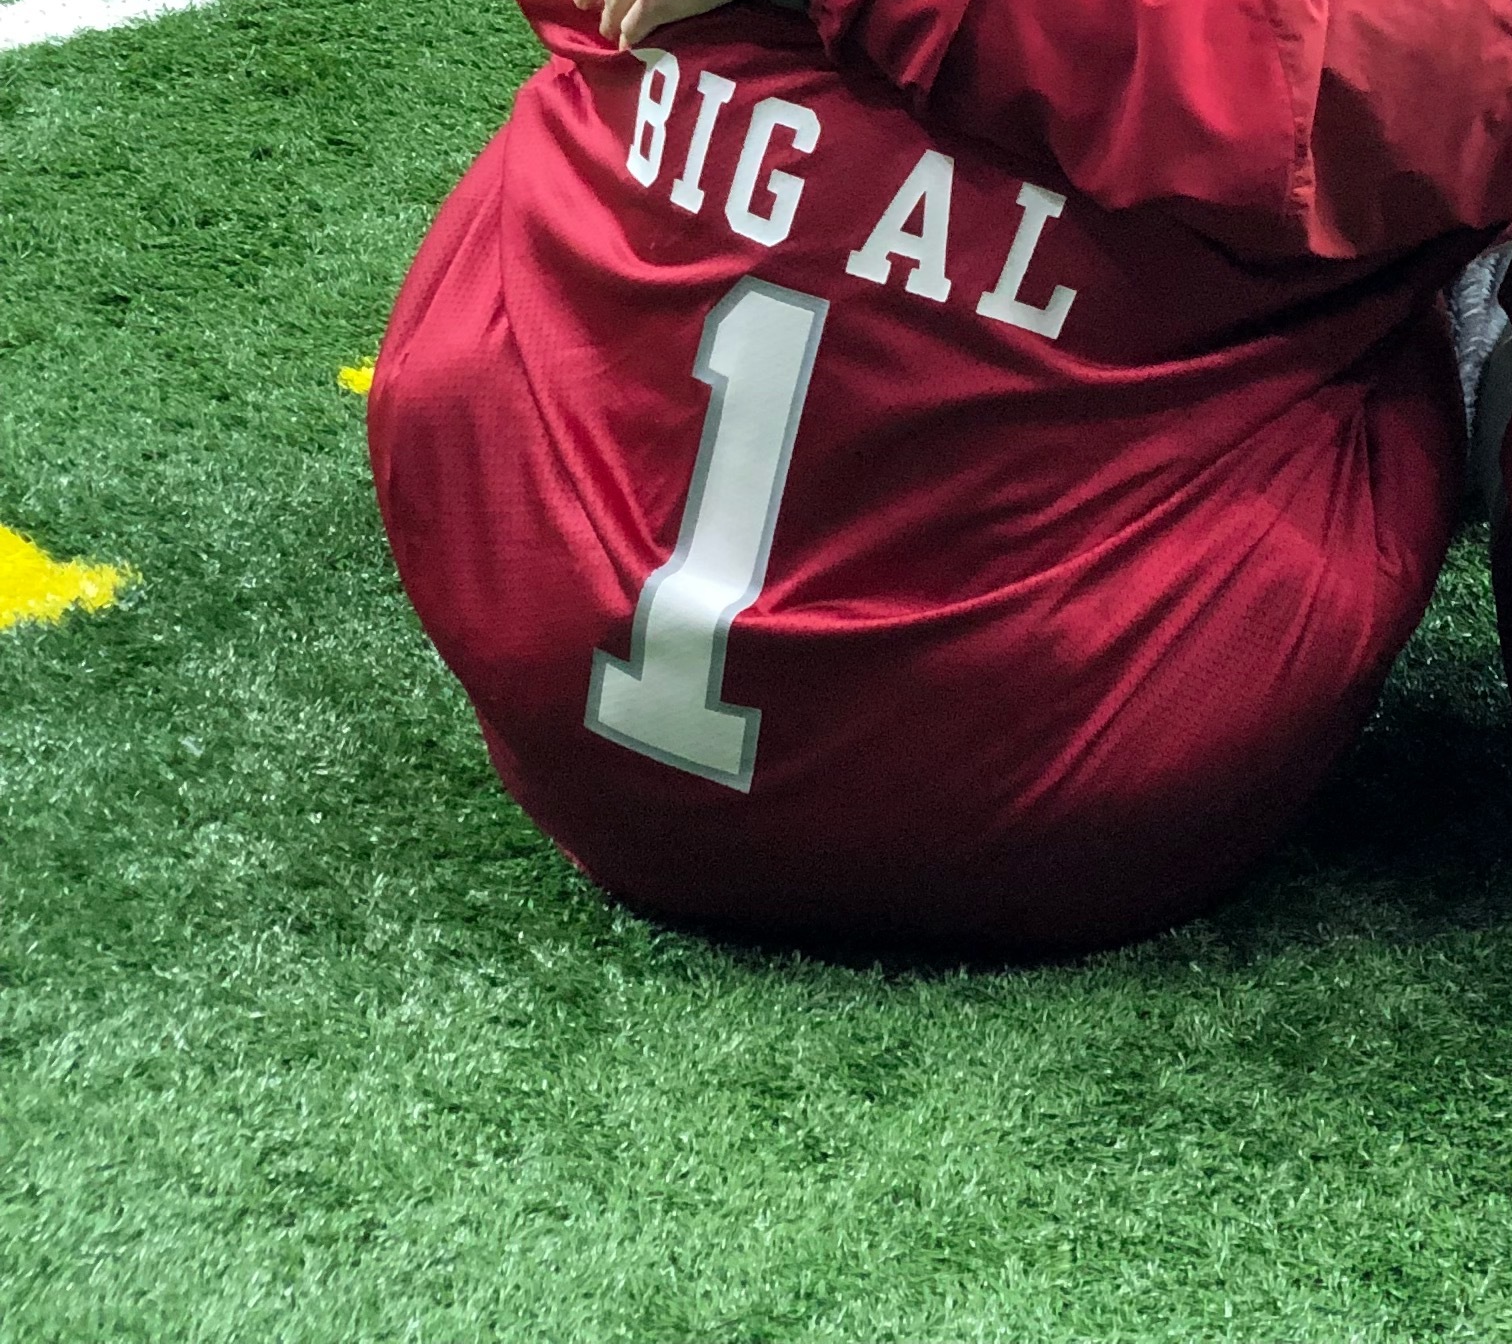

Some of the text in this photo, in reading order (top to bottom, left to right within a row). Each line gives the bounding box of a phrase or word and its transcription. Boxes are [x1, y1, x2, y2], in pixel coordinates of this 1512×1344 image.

[626, 47, 1077, 340] BIG AL
[584, 274, 830, 794] 1
